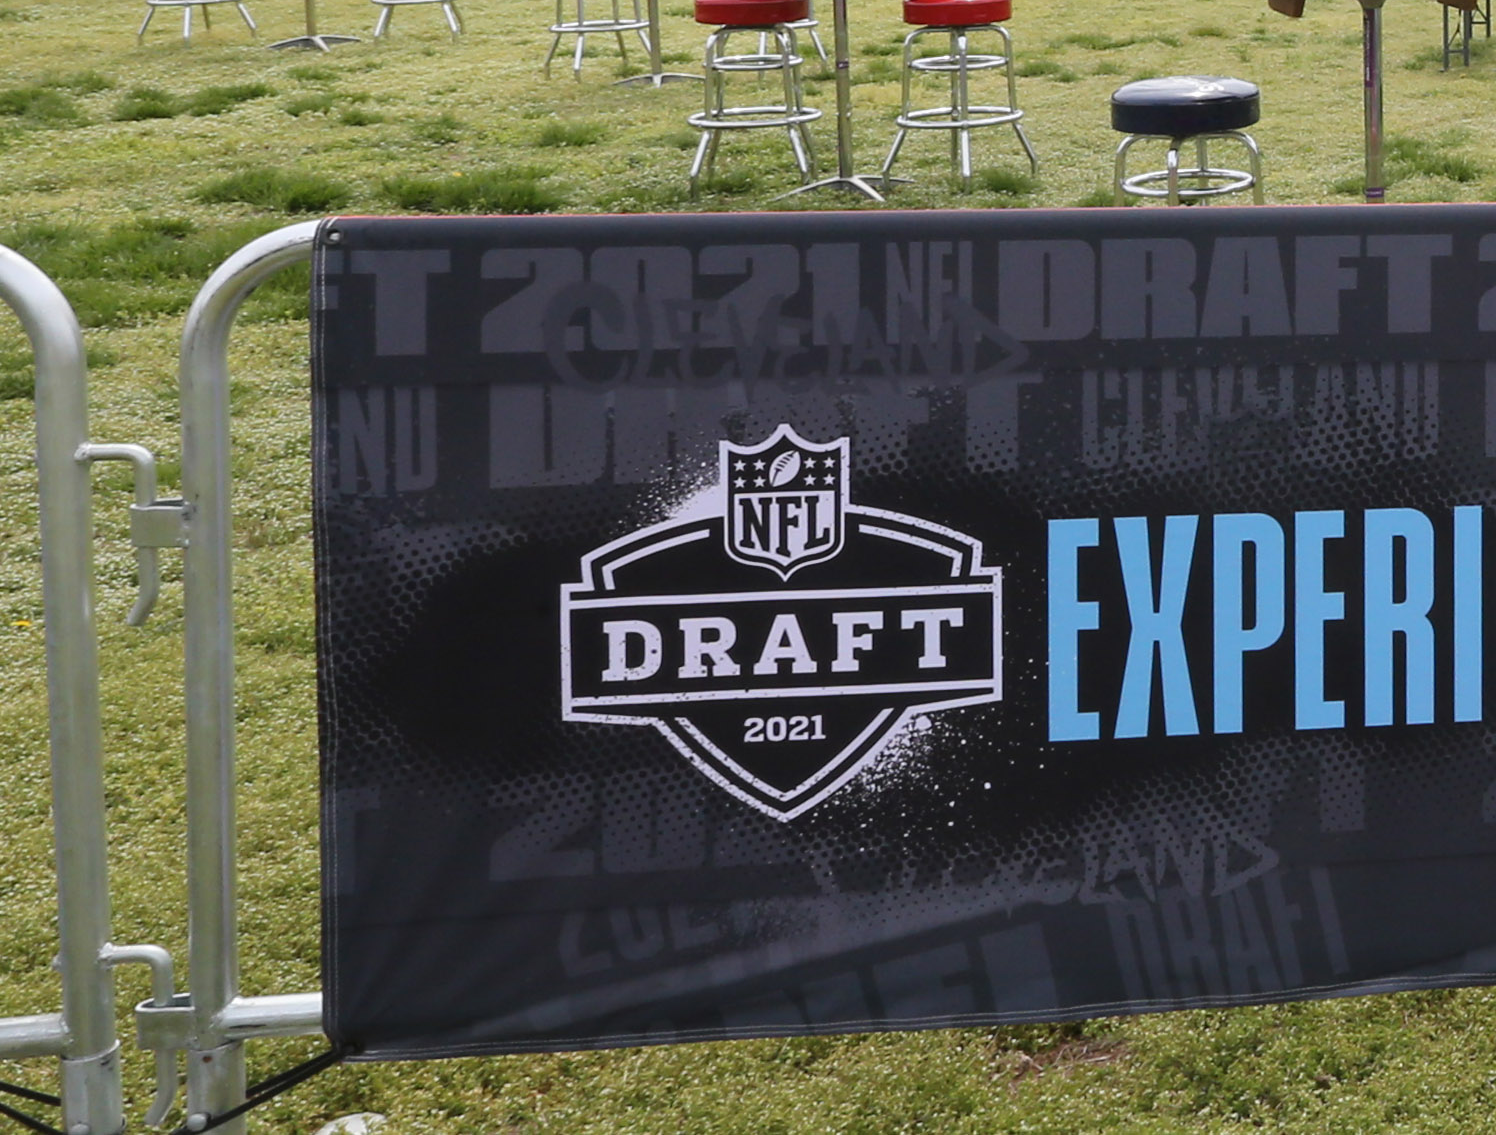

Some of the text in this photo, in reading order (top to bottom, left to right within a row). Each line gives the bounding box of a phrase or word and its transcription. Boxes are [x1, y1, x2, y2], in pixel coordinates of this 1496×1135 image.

[481, 242, 861, 355] 2021
[998, 232, 1455, 342] DRAFT
[737, 495, 834, 557] NFL
[600, 607, 965, 684] DRAFT
[743, 714, 827, 745] 2021
